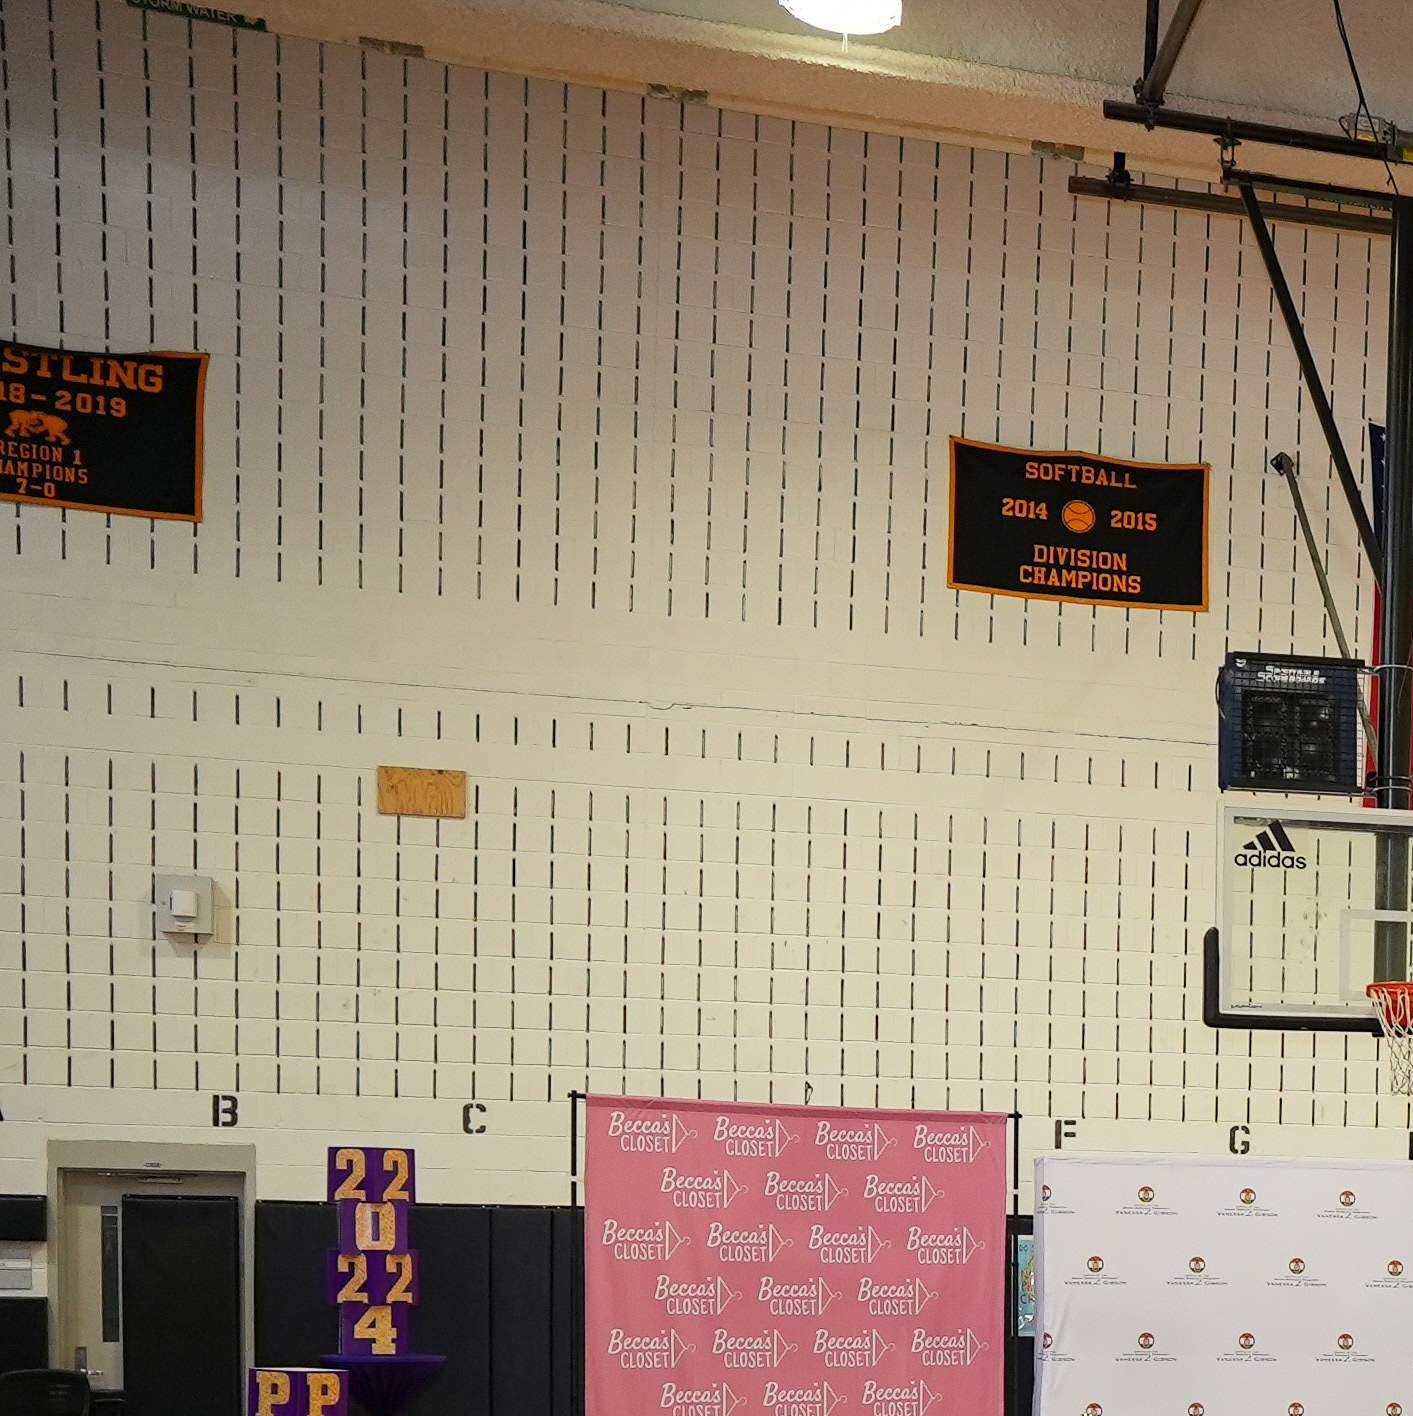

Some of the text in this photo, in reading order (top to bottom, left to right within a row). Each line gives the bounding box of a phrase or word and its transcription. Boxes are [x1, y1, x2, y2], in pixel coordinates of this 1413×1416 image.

[1025, 461, 1137, 489] SOFTBALL
[1001, 498, 1157, 531] 2014 2015
[1033, 544, 1127, 571] DIVISION
[1019, 565, 1141, 594] CHAMPIONS
[1234, 851, 1307, 869] adidas
[212, 1094, 238, 1127] B
[462, 1103, 487, 1135] C
[608, 1111, 670, 1136] Becca's
[1054, 1119, 1078, 1149] F
[620, 1134, 670, 1153] CLOSET
[914, 1125, 968, 1147] Becca's
[1229, 1125, 1250, 1155] G
[925, 1145, 968, 1163] CLOSET
[334, 1148, 366, 1201] 2
[382, 1149, 410, 1202] 2
[765, 1171, 823, 1194] Becca's
[776, 1192, 823, 1211] CLOSET
[603, 1219, 663, 1243] Becca's
[809, 1225, 866, 1247] Becca's
[615, 1241, 663, 1261] CLOSET
[820, 1245, 866, 1264] CLOSET
[337, 1252, 369, 1303] 2
[385, 1252, 413, 1303] 2
[655, 1275, 715, 1298] Becca's
[667, 1296, 715, 1316] CLOSET
[354, 1305, 397, 1355] 4
[609, 1329, 669, 1351] Becca's
[912, 1329, 965, 1350] Becca's
[621, 1349, 669, 1369] CLOSET
[922, 1348, 965, 1367] CLOSET
[764, 1382, 822, 1404] Becca's
